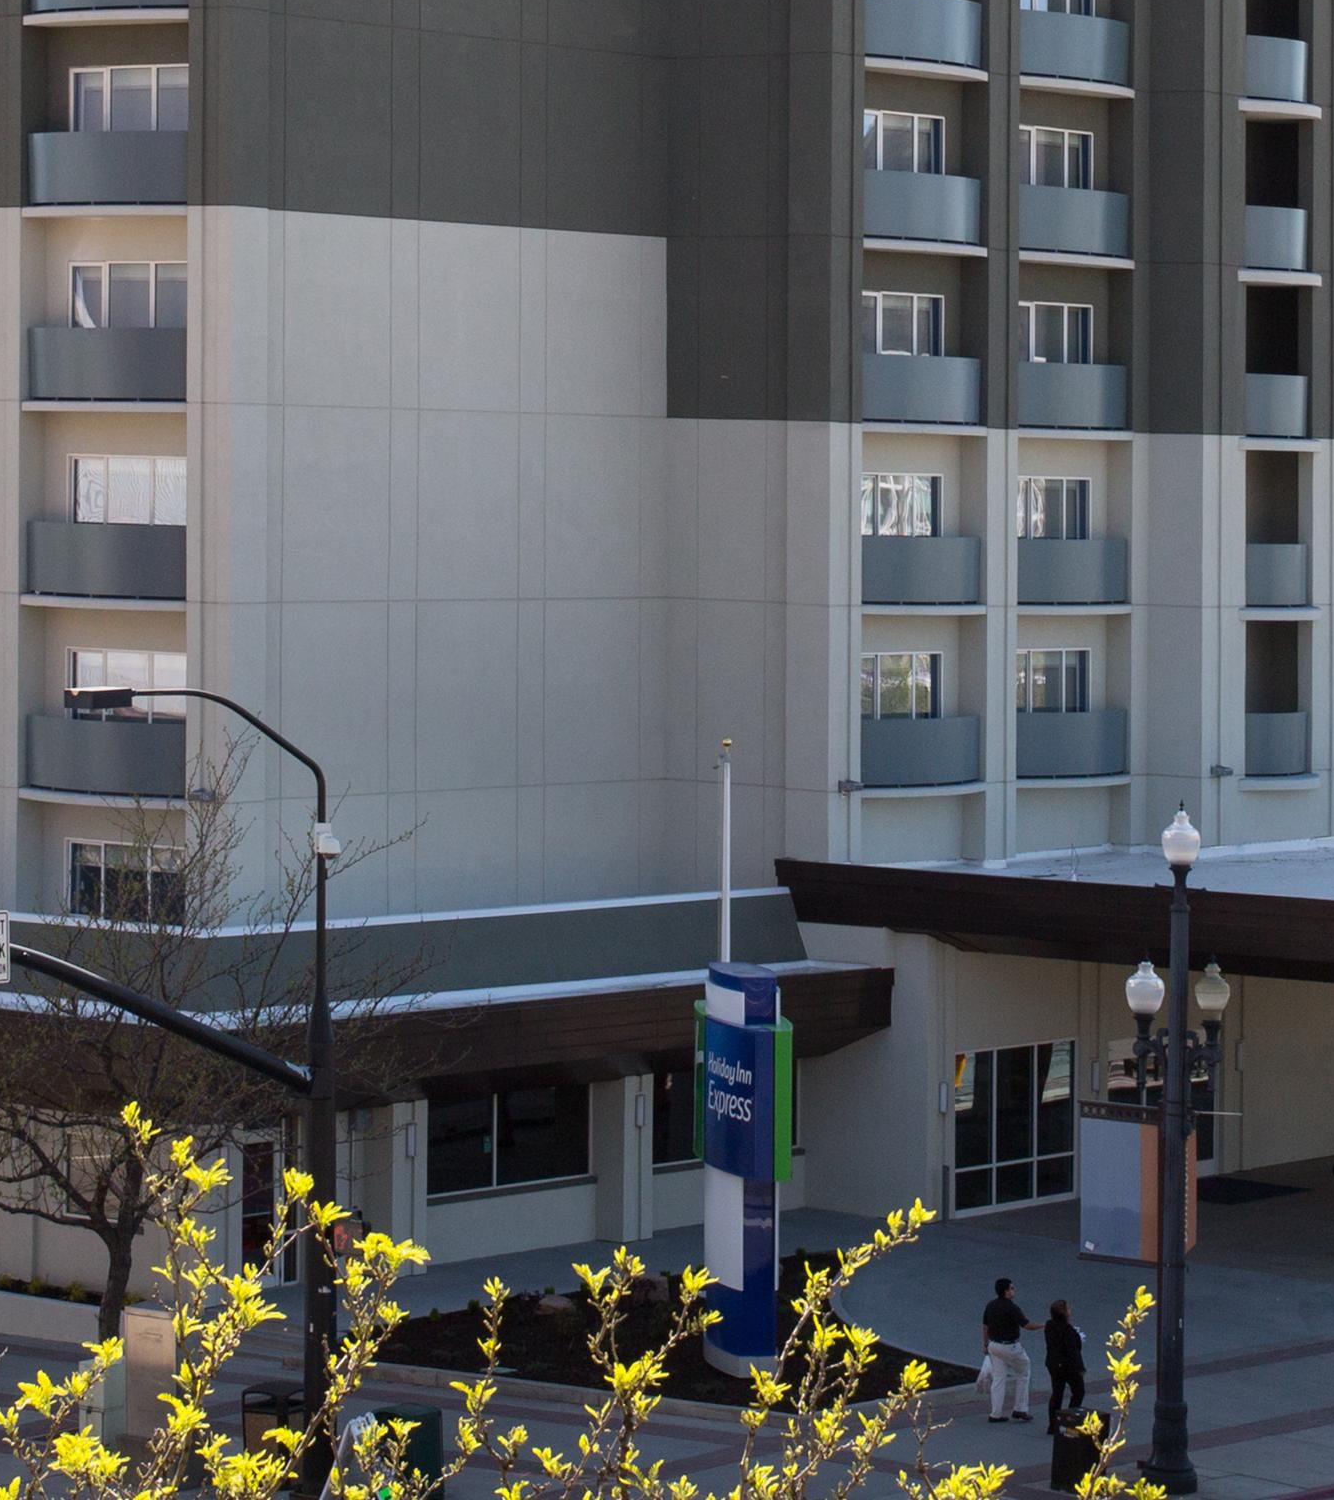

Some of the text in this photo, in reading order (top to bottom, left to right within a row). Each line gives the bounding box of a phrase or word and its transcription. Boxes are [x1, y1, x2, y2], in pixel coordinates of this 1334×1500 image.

[708, 1051, 752, 1086] Holiday Inn
[708, 1079, 753, 1122] Express
